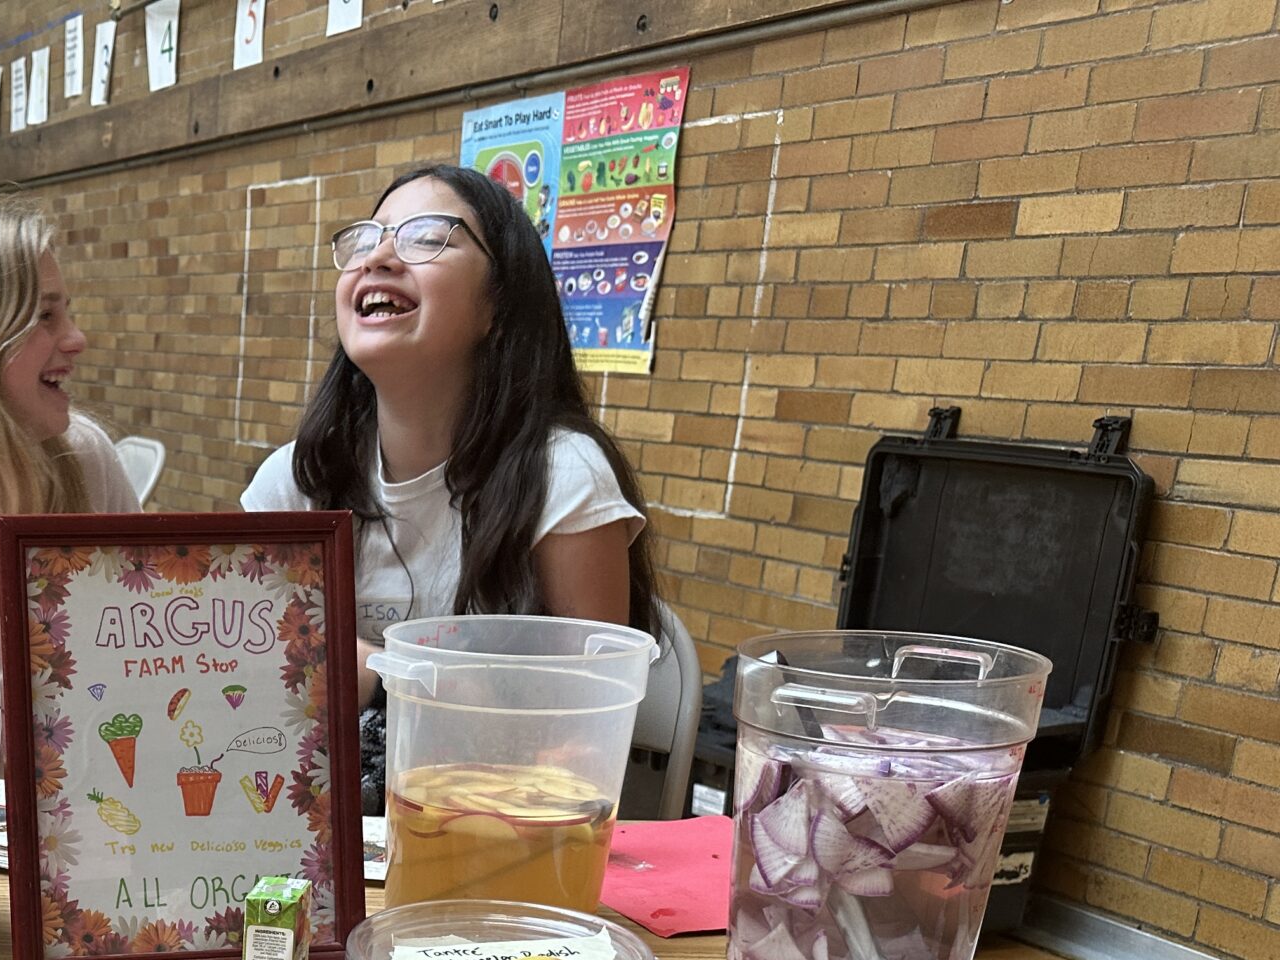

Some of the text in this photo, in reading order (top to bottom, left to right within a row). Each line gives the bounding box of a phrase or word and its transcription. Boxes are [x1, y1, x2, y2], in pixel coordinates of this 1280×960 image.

[160, 20, 173, 62] 4
[473, 107, 552, 133] Eat Smart To Play Hard
[95, 596, 276, 655] ARGUS
[124, 652, 238, 678] FARM Stop
[105, 841, 136, 855] Try
[150, 841, 175, 852] new
[115, 877, 168, 910] ALL
